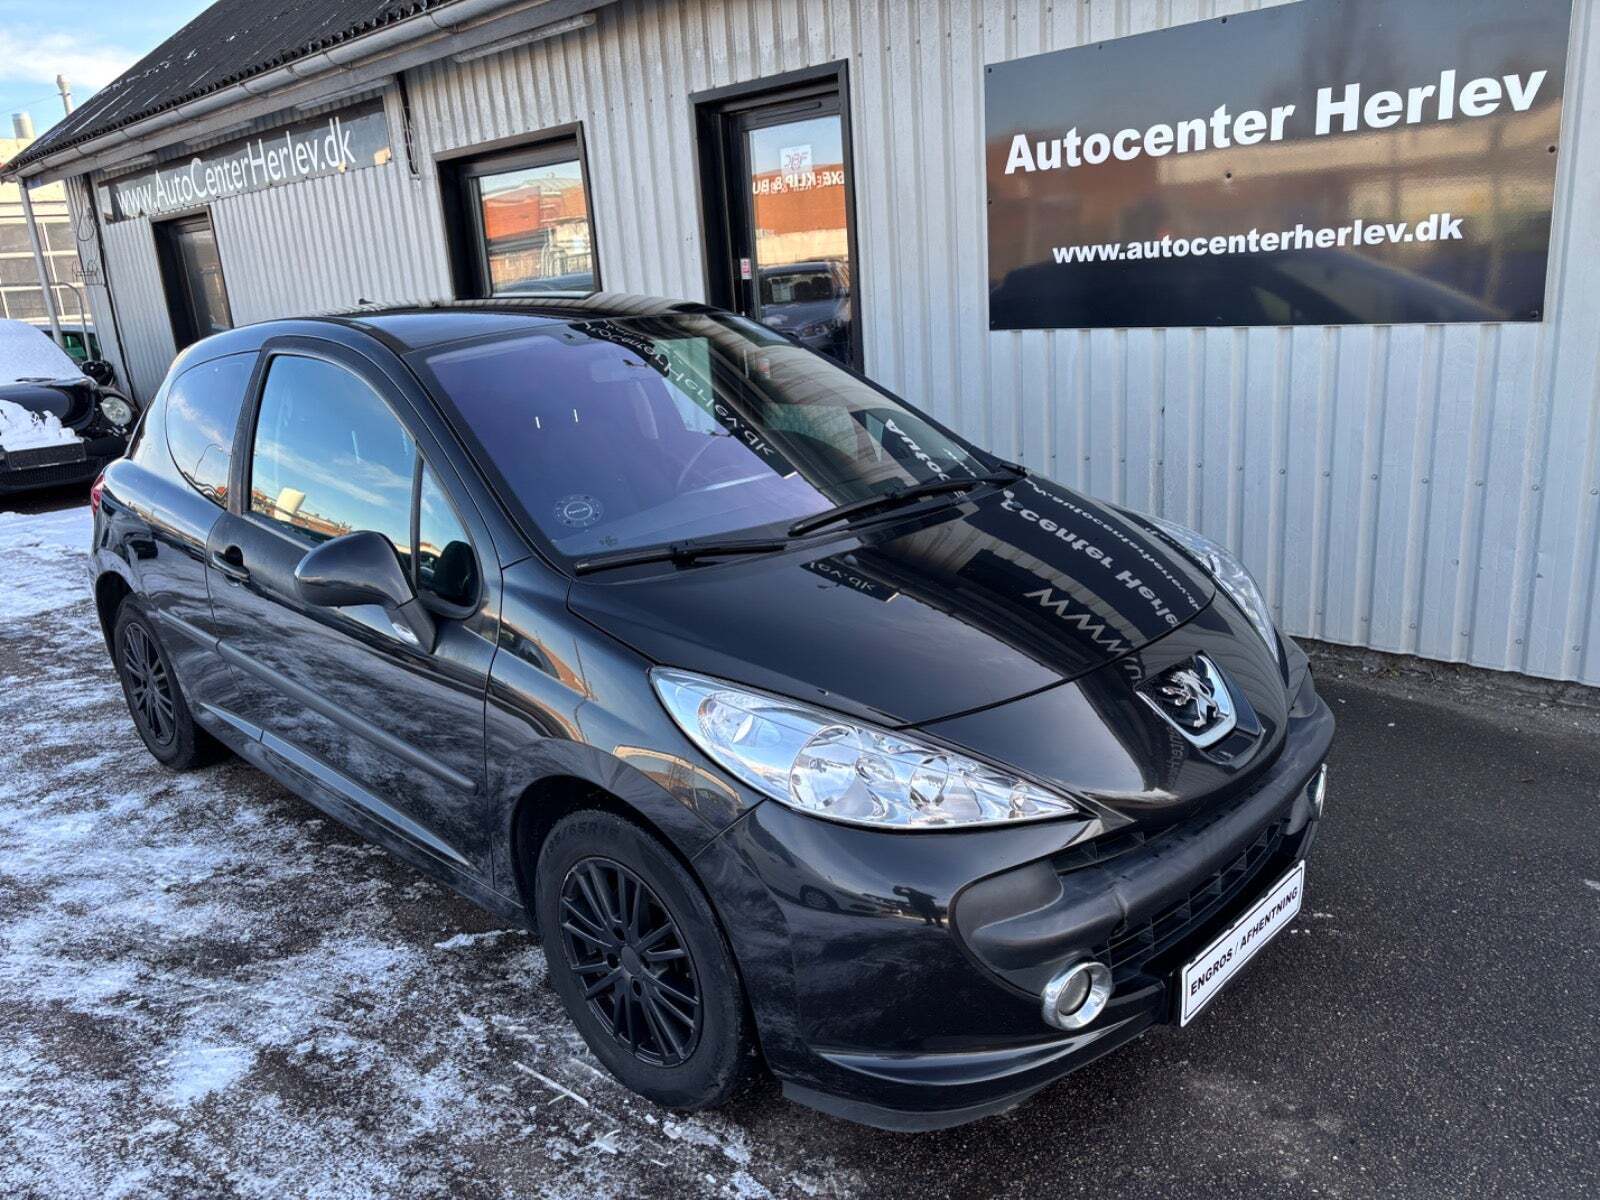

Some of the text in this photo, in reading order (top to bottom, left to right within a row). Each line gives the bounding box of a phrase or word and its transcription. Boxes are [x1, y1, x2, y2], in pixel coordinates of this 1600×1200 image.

[116, 116, 356, 215] www.AutoCenterHerlev.dk
[1004, 69, 1547, 174] Autocenter Herlev
[1052, 213, 1462, 264] www.autocenterherlev.dk
[1190, 948, 1233, 997] ENGROS
[1240, 886, 1298, 949] AFHENTNING
